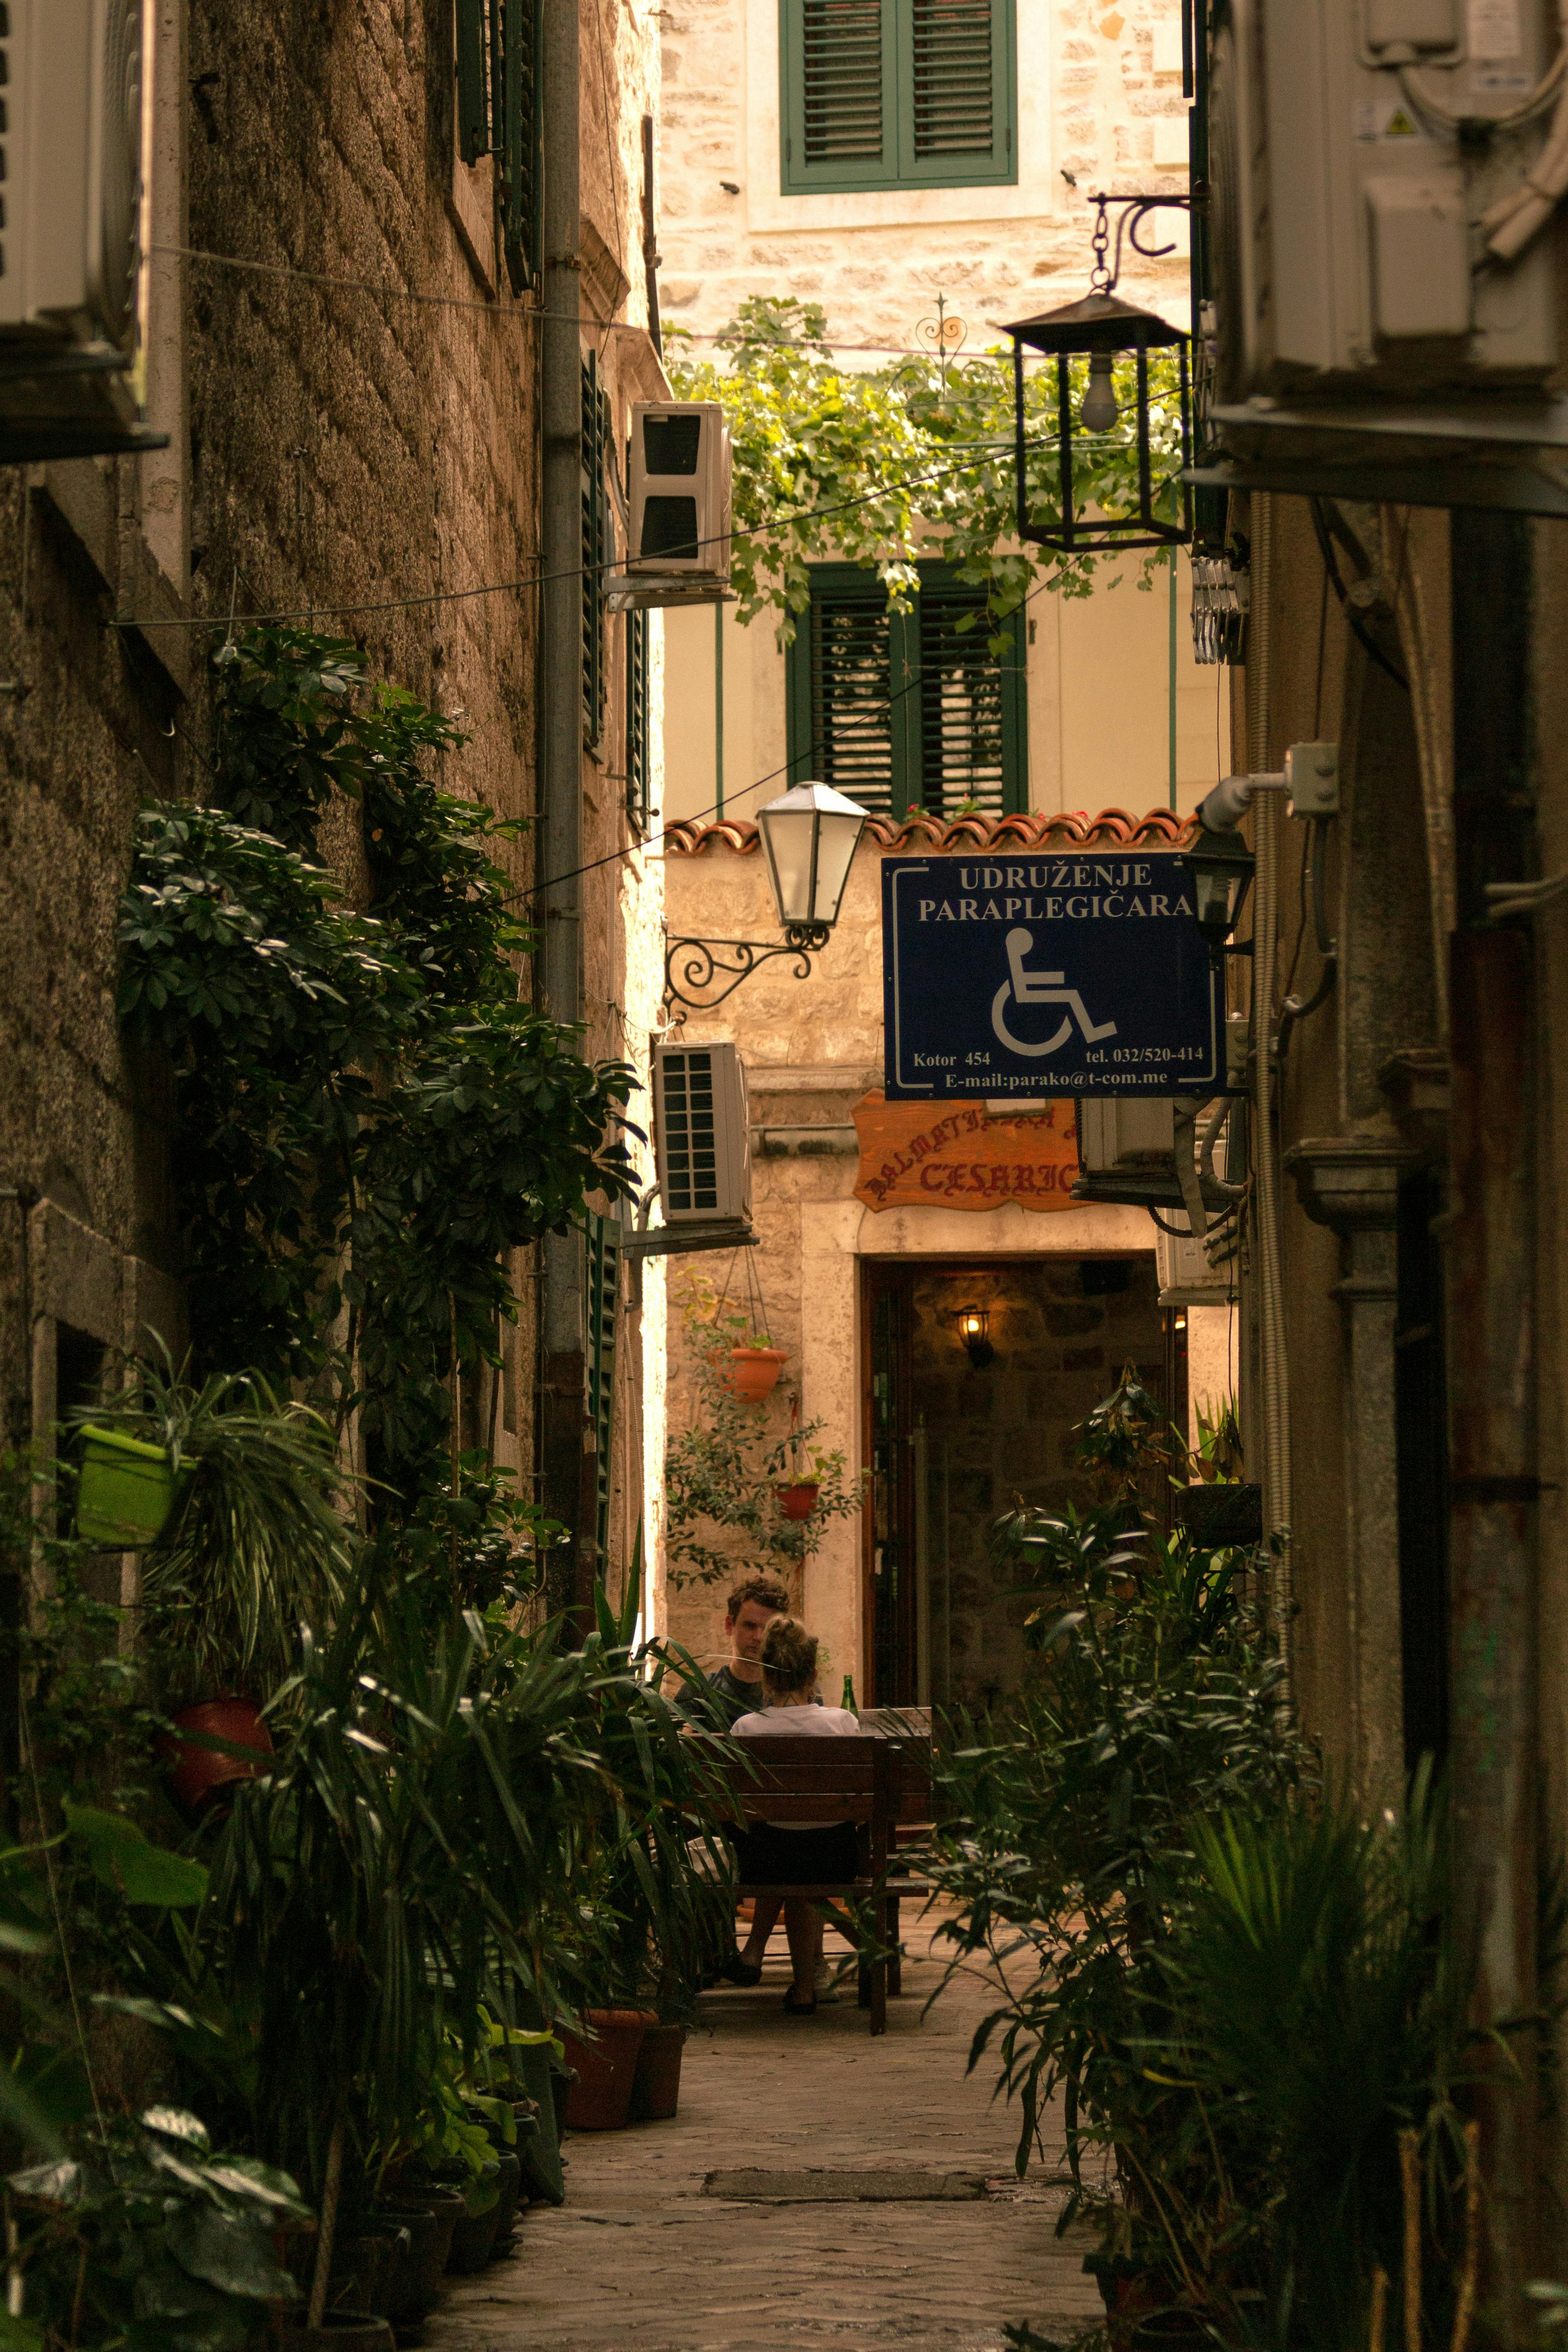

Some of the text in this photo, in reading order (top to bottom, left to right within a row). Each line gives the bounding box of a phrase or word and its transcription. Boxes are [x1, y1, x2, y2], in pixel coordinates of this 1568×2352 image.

[959, 860, 1152, 890] UDRUŽENJE
[918, 890, 1194, 922] PARAPLEGIČARA
[913, 1052, 990, 1067] Kotor 454
[1086, 1047, 1204, 1063] tel. 032/520-414
[945, 1071, 1168, 1089] E-mail:parako@t-com.me
